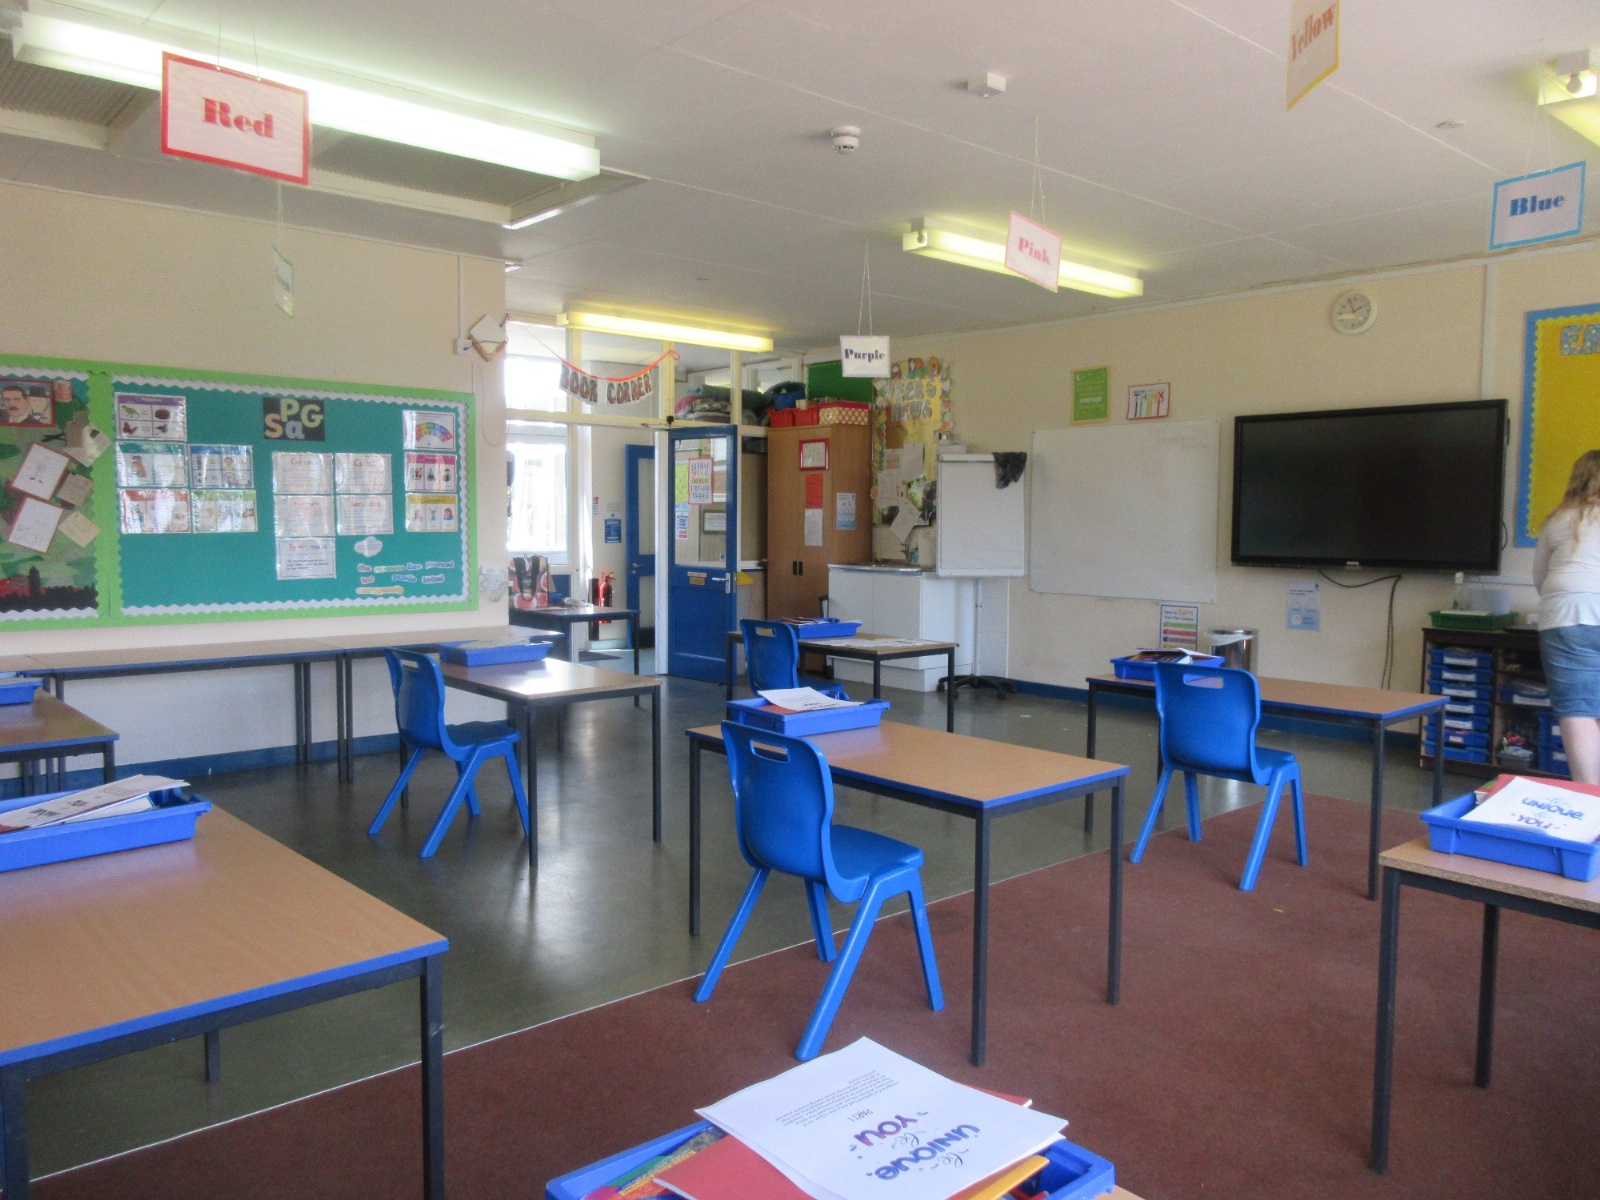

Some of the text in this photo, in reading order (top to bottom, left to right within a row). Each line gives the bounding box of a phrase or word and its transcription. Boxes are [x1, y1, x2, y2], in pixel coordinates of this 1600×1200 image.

[202, 97, 275, 139] Red
[1508, 192, 1566, 218] Blue
[1018, 236, 1051, 266] Pink
[844, 348, 886, 363] Purple
[559, 362, 653, 405] BOOK CORNER
[853, 1114, 918, 1147] YOU
